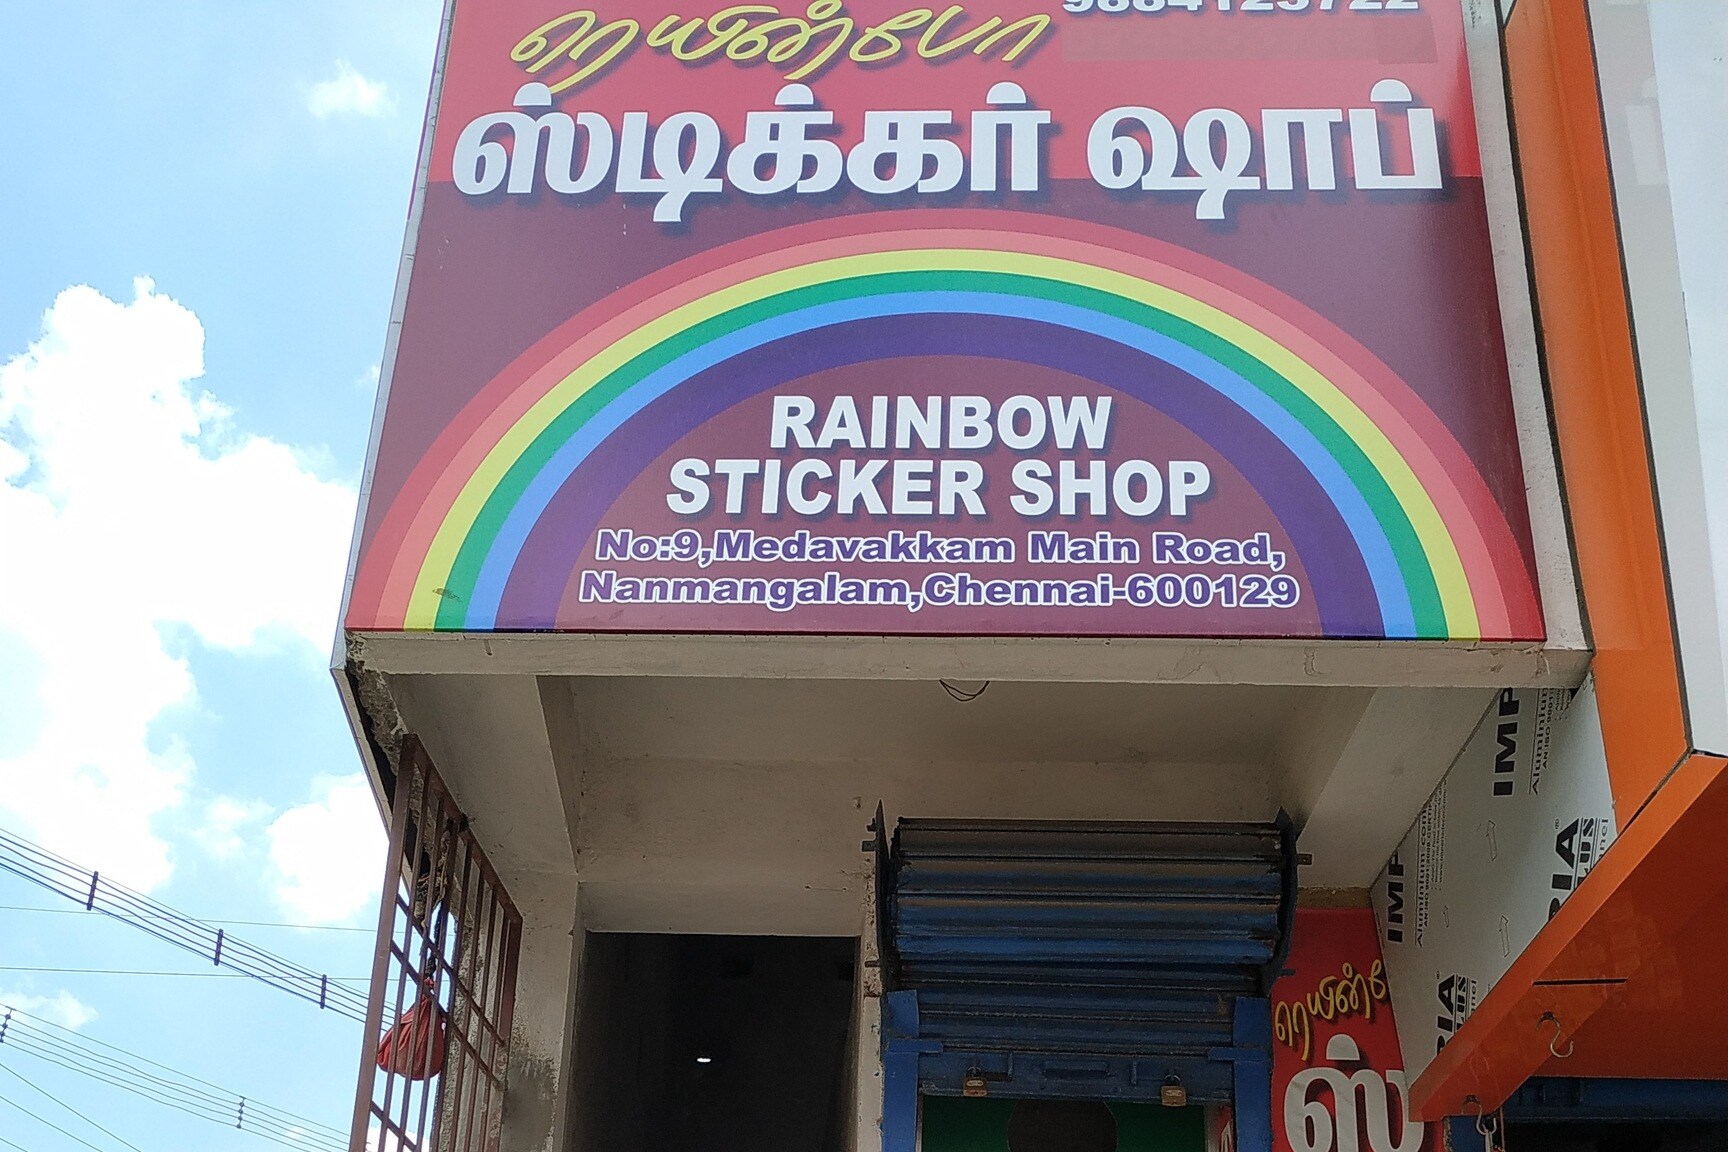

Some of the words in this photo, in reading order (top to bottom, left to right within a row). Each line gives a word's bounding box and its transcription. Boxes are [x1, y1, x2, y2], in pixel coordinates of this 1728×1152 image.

[1086, 79, 1443, 220] ஷாப்
[770, 395, 1112, 450] RAINBOW
[666, 459, 983, 516] STICKER
[1010, 460, 1211, 516] SHOP
[597, 528, 1014, 566] No:9,Medavakkam
[1029, 531, 1140, 565] Main
[1153, 532, 1287, 571] Road,
[580, 570, 1300, 611] Nanmangalam,Chennai-600129
[1416, 854, 1427, 948] Aluminium
